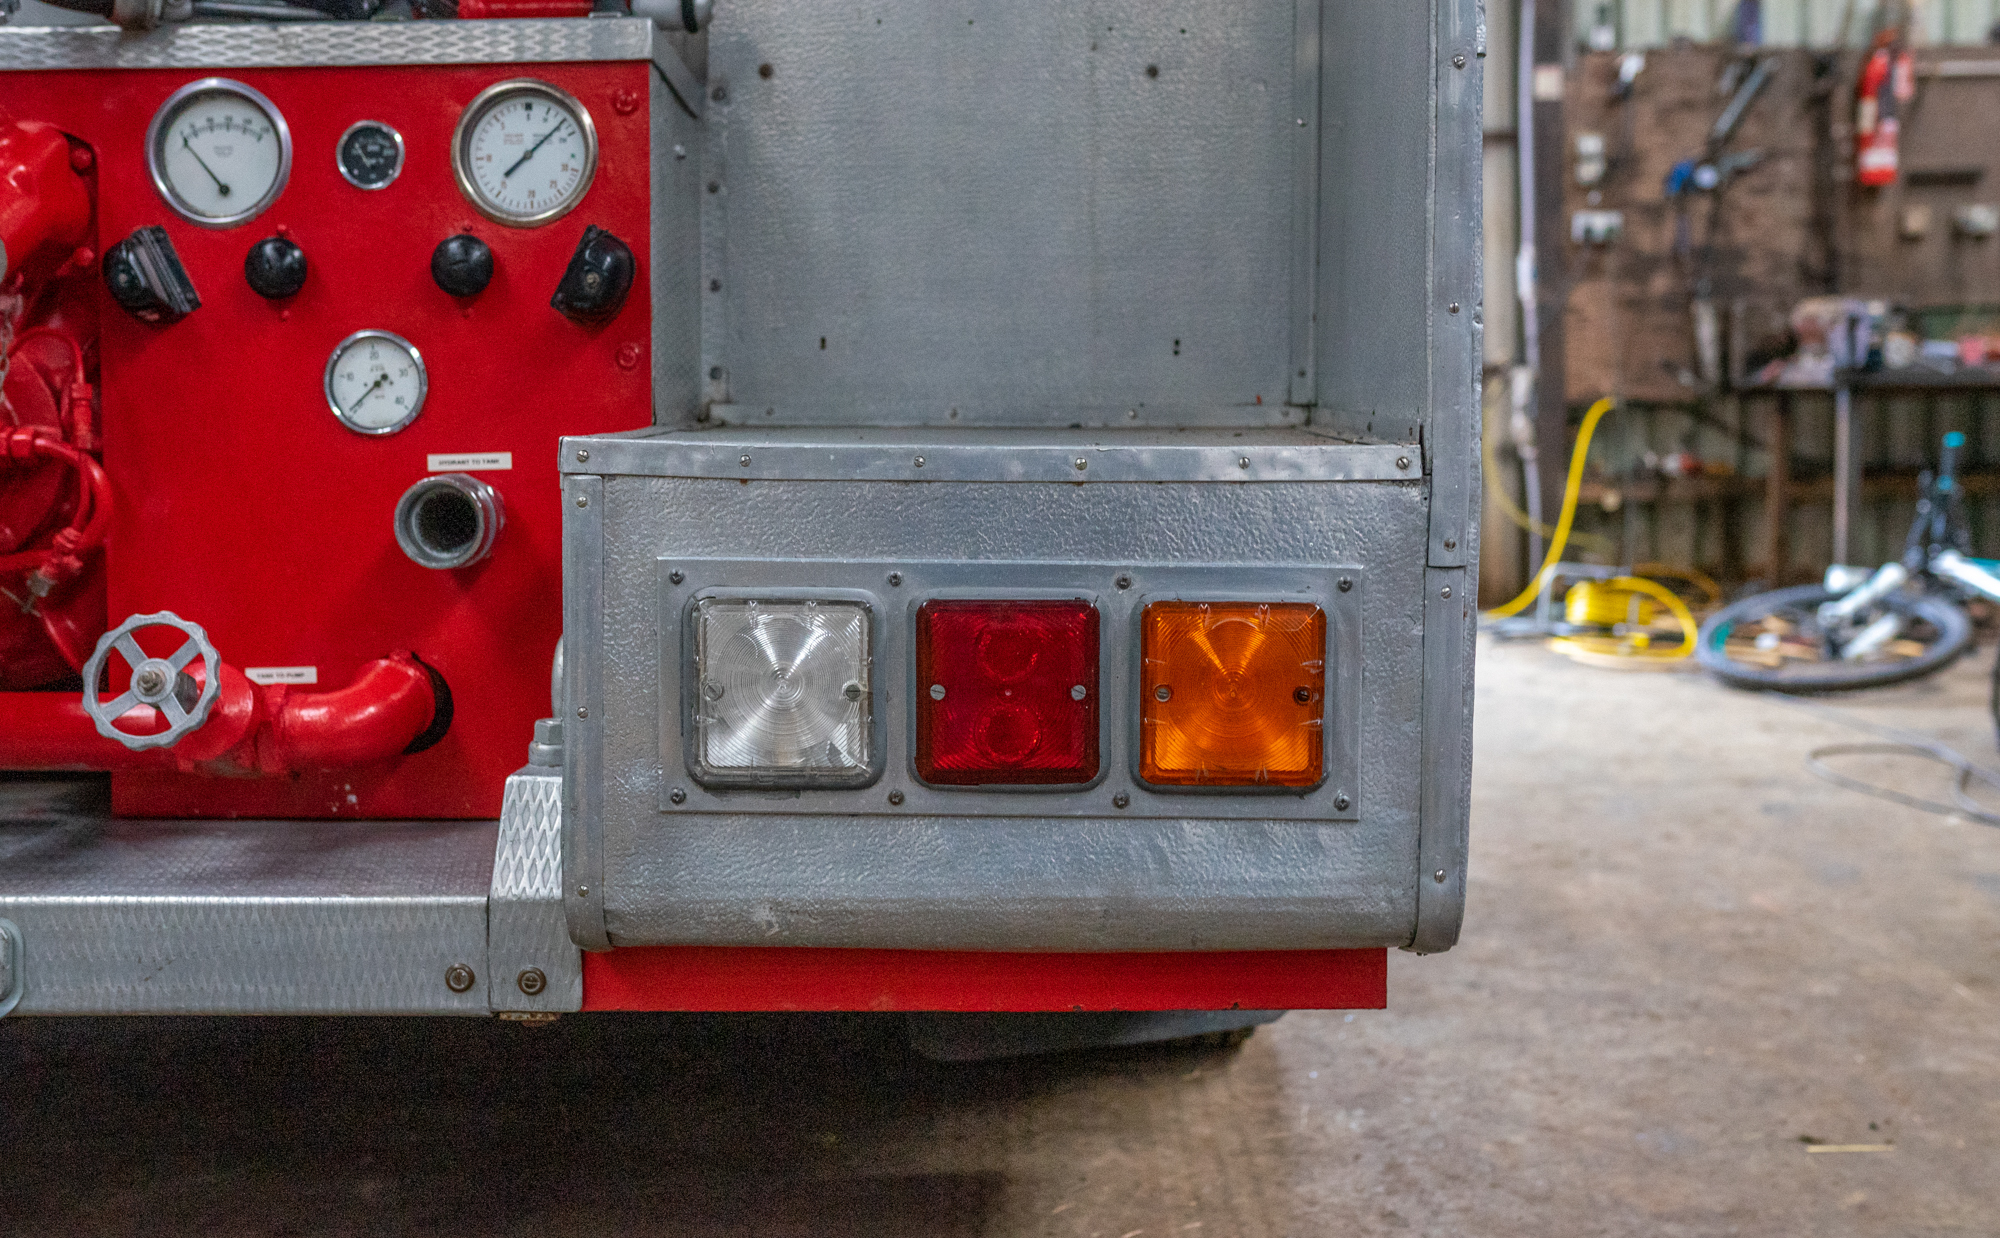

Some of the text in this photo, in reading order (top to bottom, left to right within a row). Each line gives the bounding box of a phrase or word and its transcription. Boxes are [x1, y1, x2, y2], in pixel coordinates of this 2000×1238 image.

[370, 351, 379, 360] 20
[399, 368, 408, 378] 30
[395, 396, 405, 405] 40
